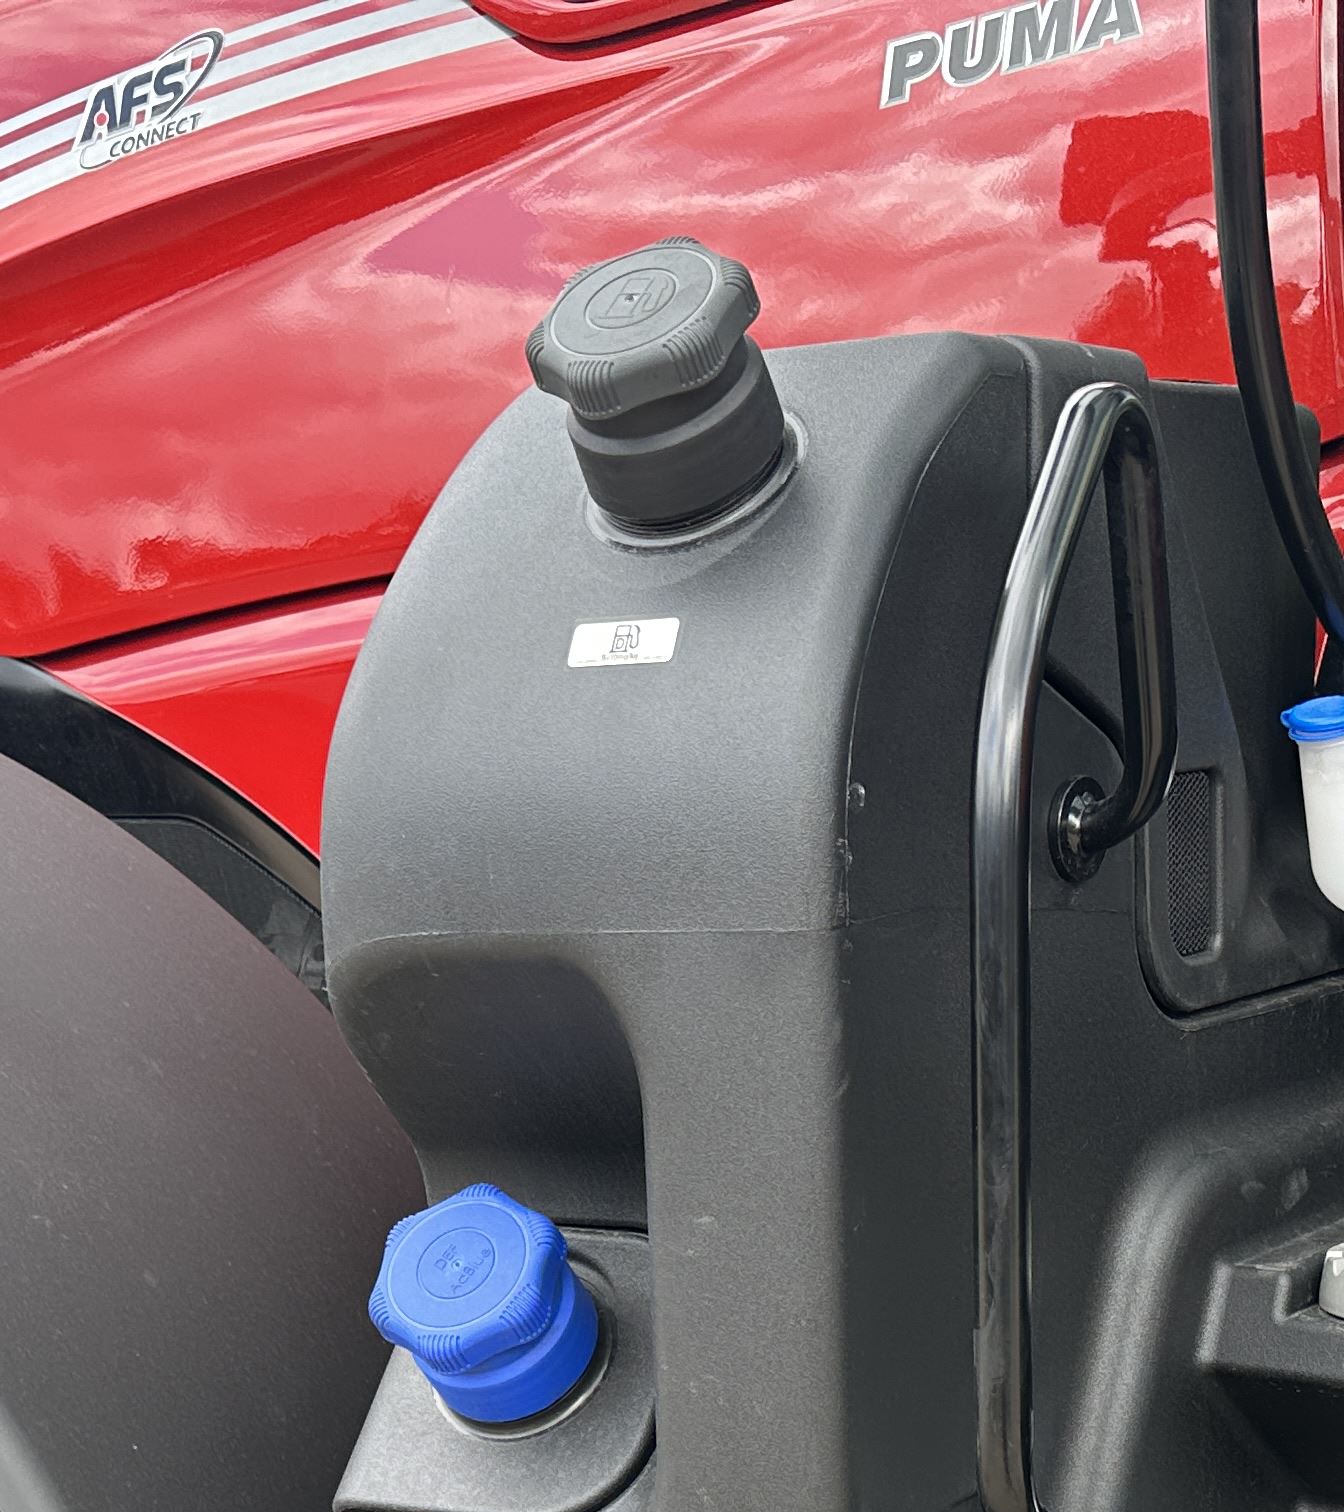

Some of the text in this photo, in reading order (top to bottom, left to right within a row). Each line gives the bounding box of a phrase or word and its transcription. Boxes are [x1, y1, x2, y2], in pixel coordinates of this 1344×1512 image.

[880, 0, 1142, 108] PUMA
[80, 58, 187, 144] AFS
[109, 112, 202, 158] CONNECT
